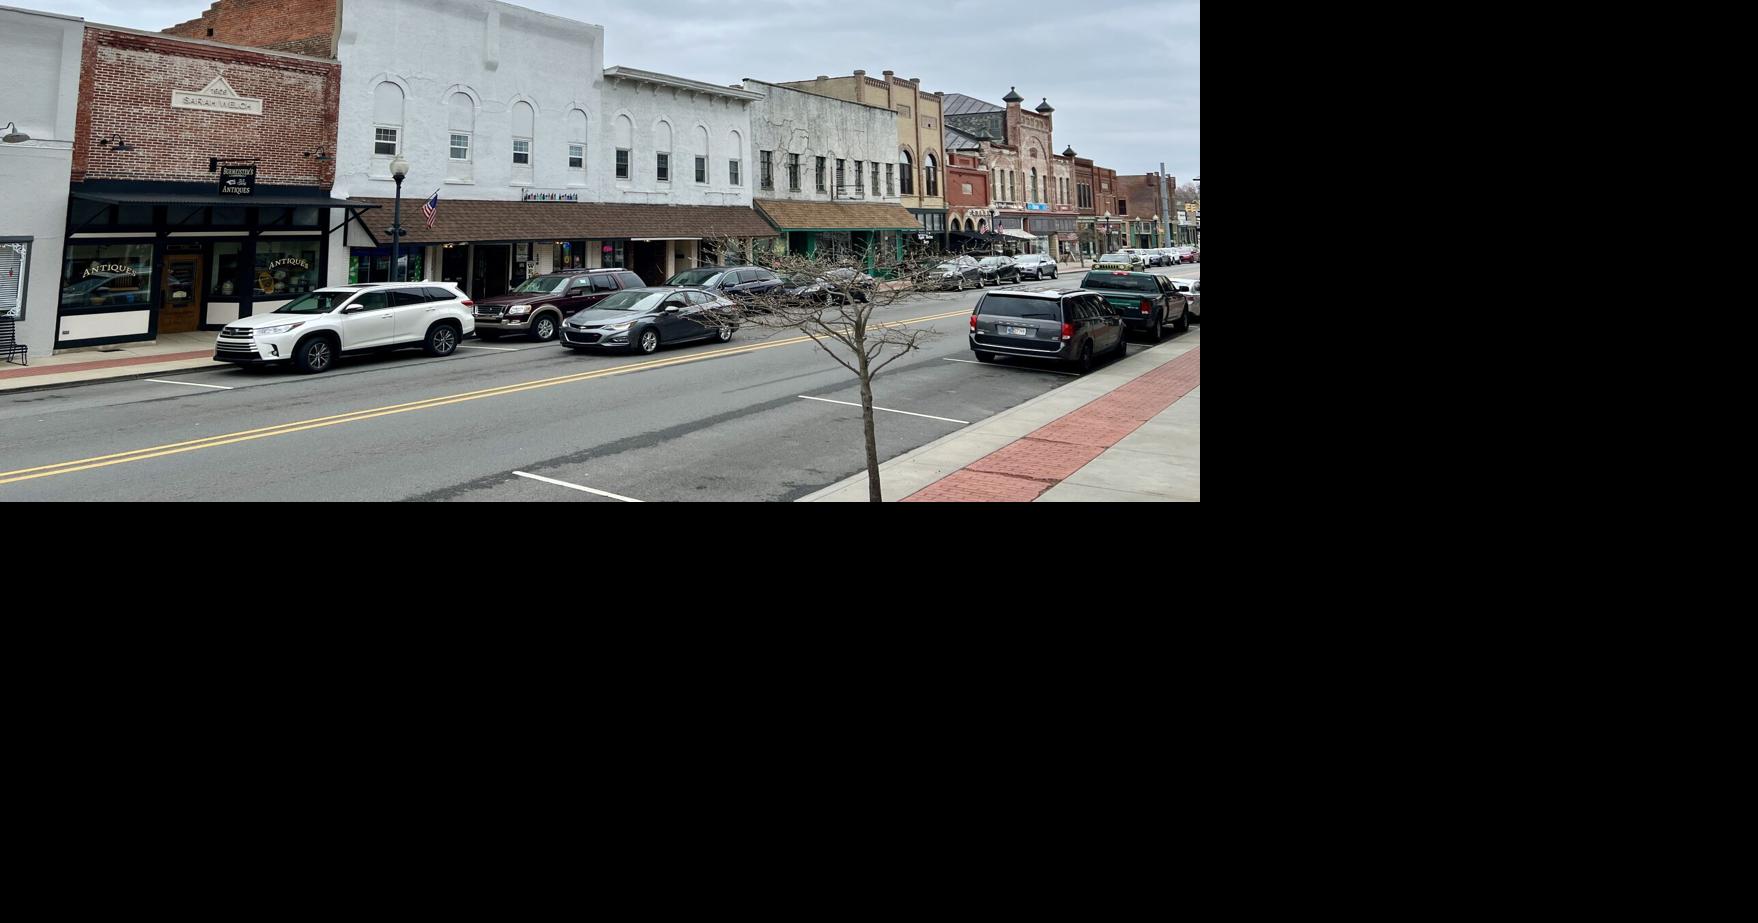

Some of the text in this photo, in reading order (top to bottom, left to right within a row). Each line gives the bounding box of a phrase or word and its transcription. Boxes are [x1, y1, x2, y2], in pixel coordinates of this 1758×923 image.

[222, 185, 250, 195] ANTIQUES
[269, 257, 309, 270] ANTIQUES
[82, 263, 137, 278] ANTIQUES
